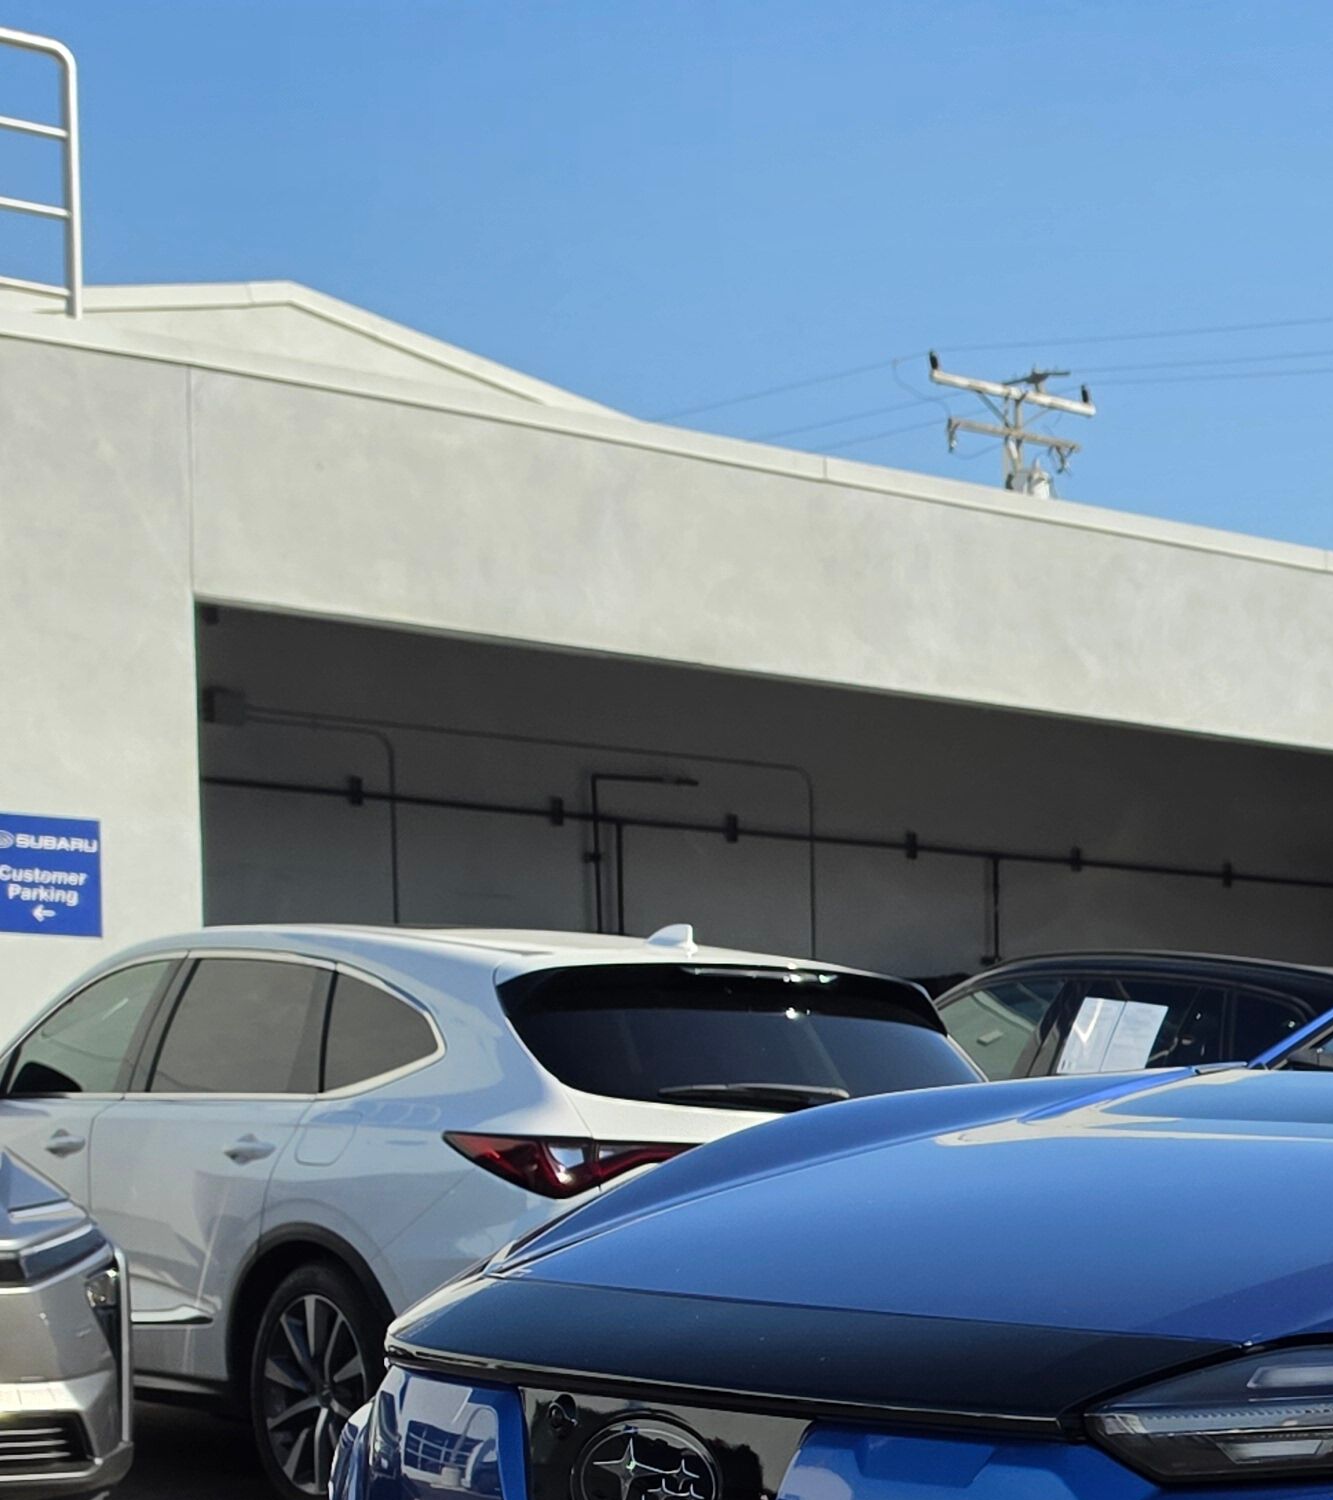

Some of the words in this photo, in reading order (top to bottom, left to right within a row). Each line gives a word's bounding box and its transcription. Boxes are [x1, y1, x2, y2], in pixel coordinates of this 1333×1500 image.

[15, 833, 98, 853] SUBARU
[0, 864, 88, 886] Customer
[7, 884, 79, 906] Parking
